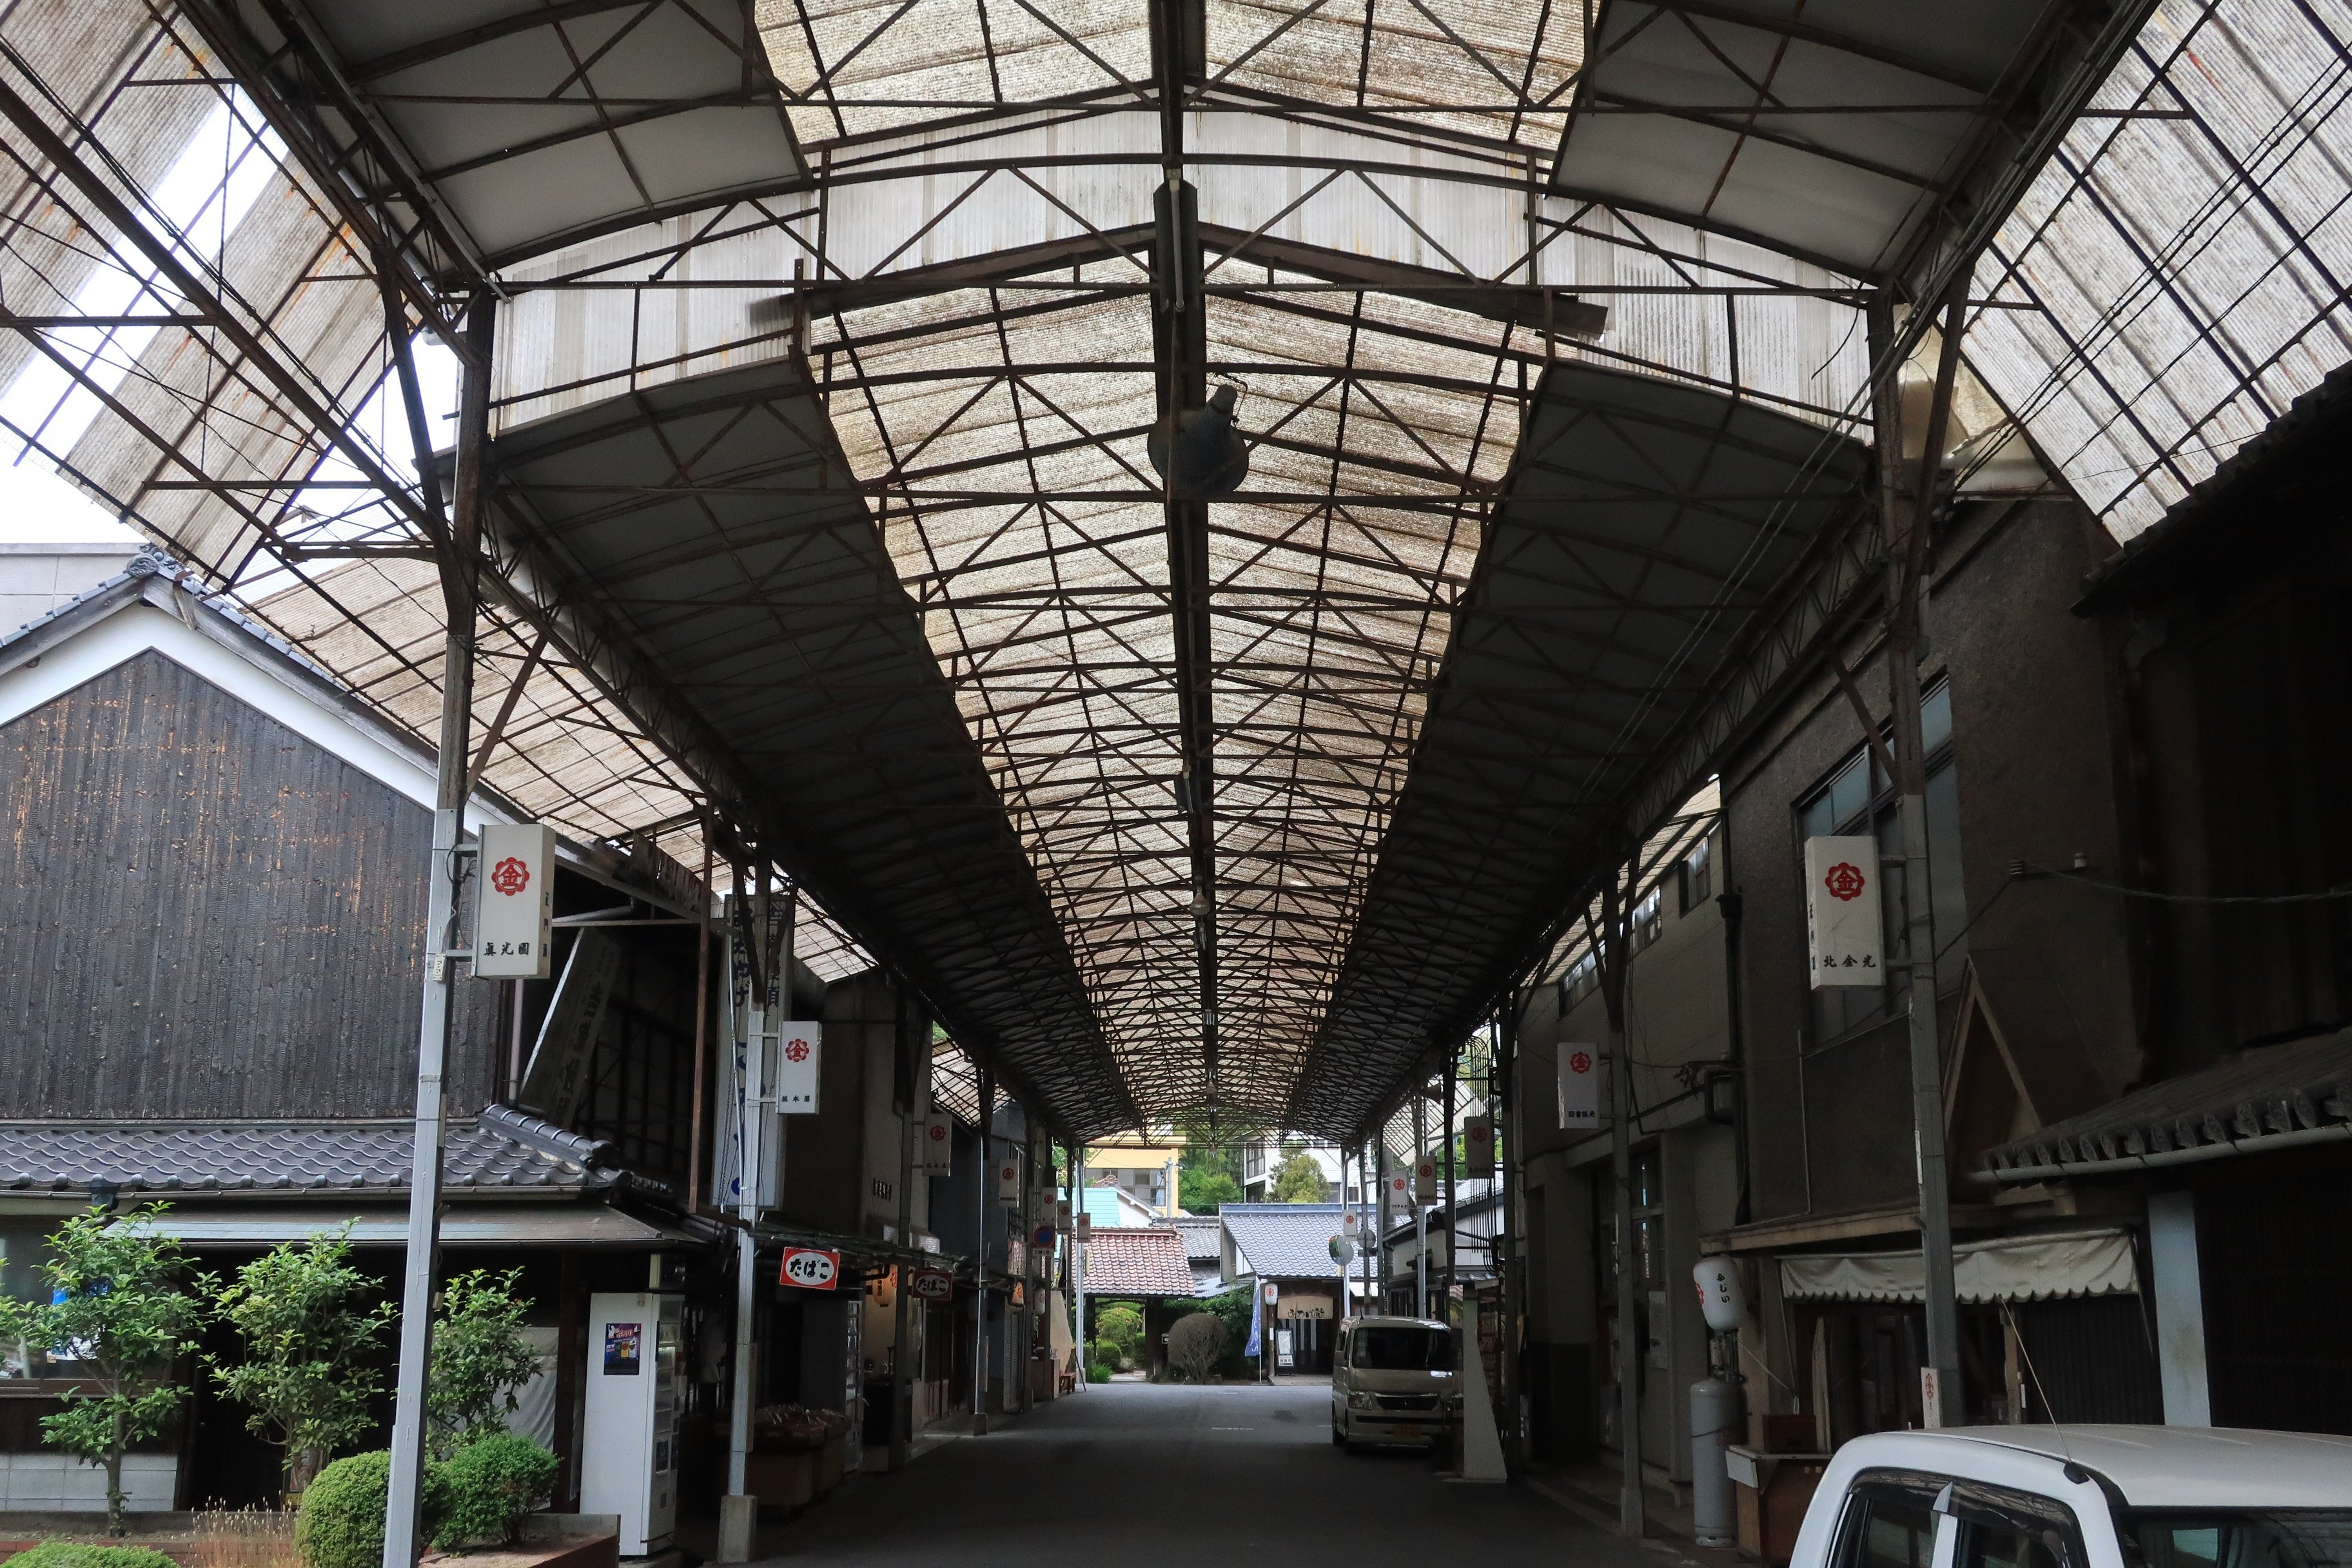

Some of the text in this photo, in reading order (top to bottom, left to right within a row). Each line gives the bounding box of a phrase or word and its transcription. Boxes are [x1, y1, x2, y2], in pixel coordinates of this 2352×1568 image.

[789, 1257, 830, 1280] たばこ
[917, 1277, 946, 1292] たばこ
